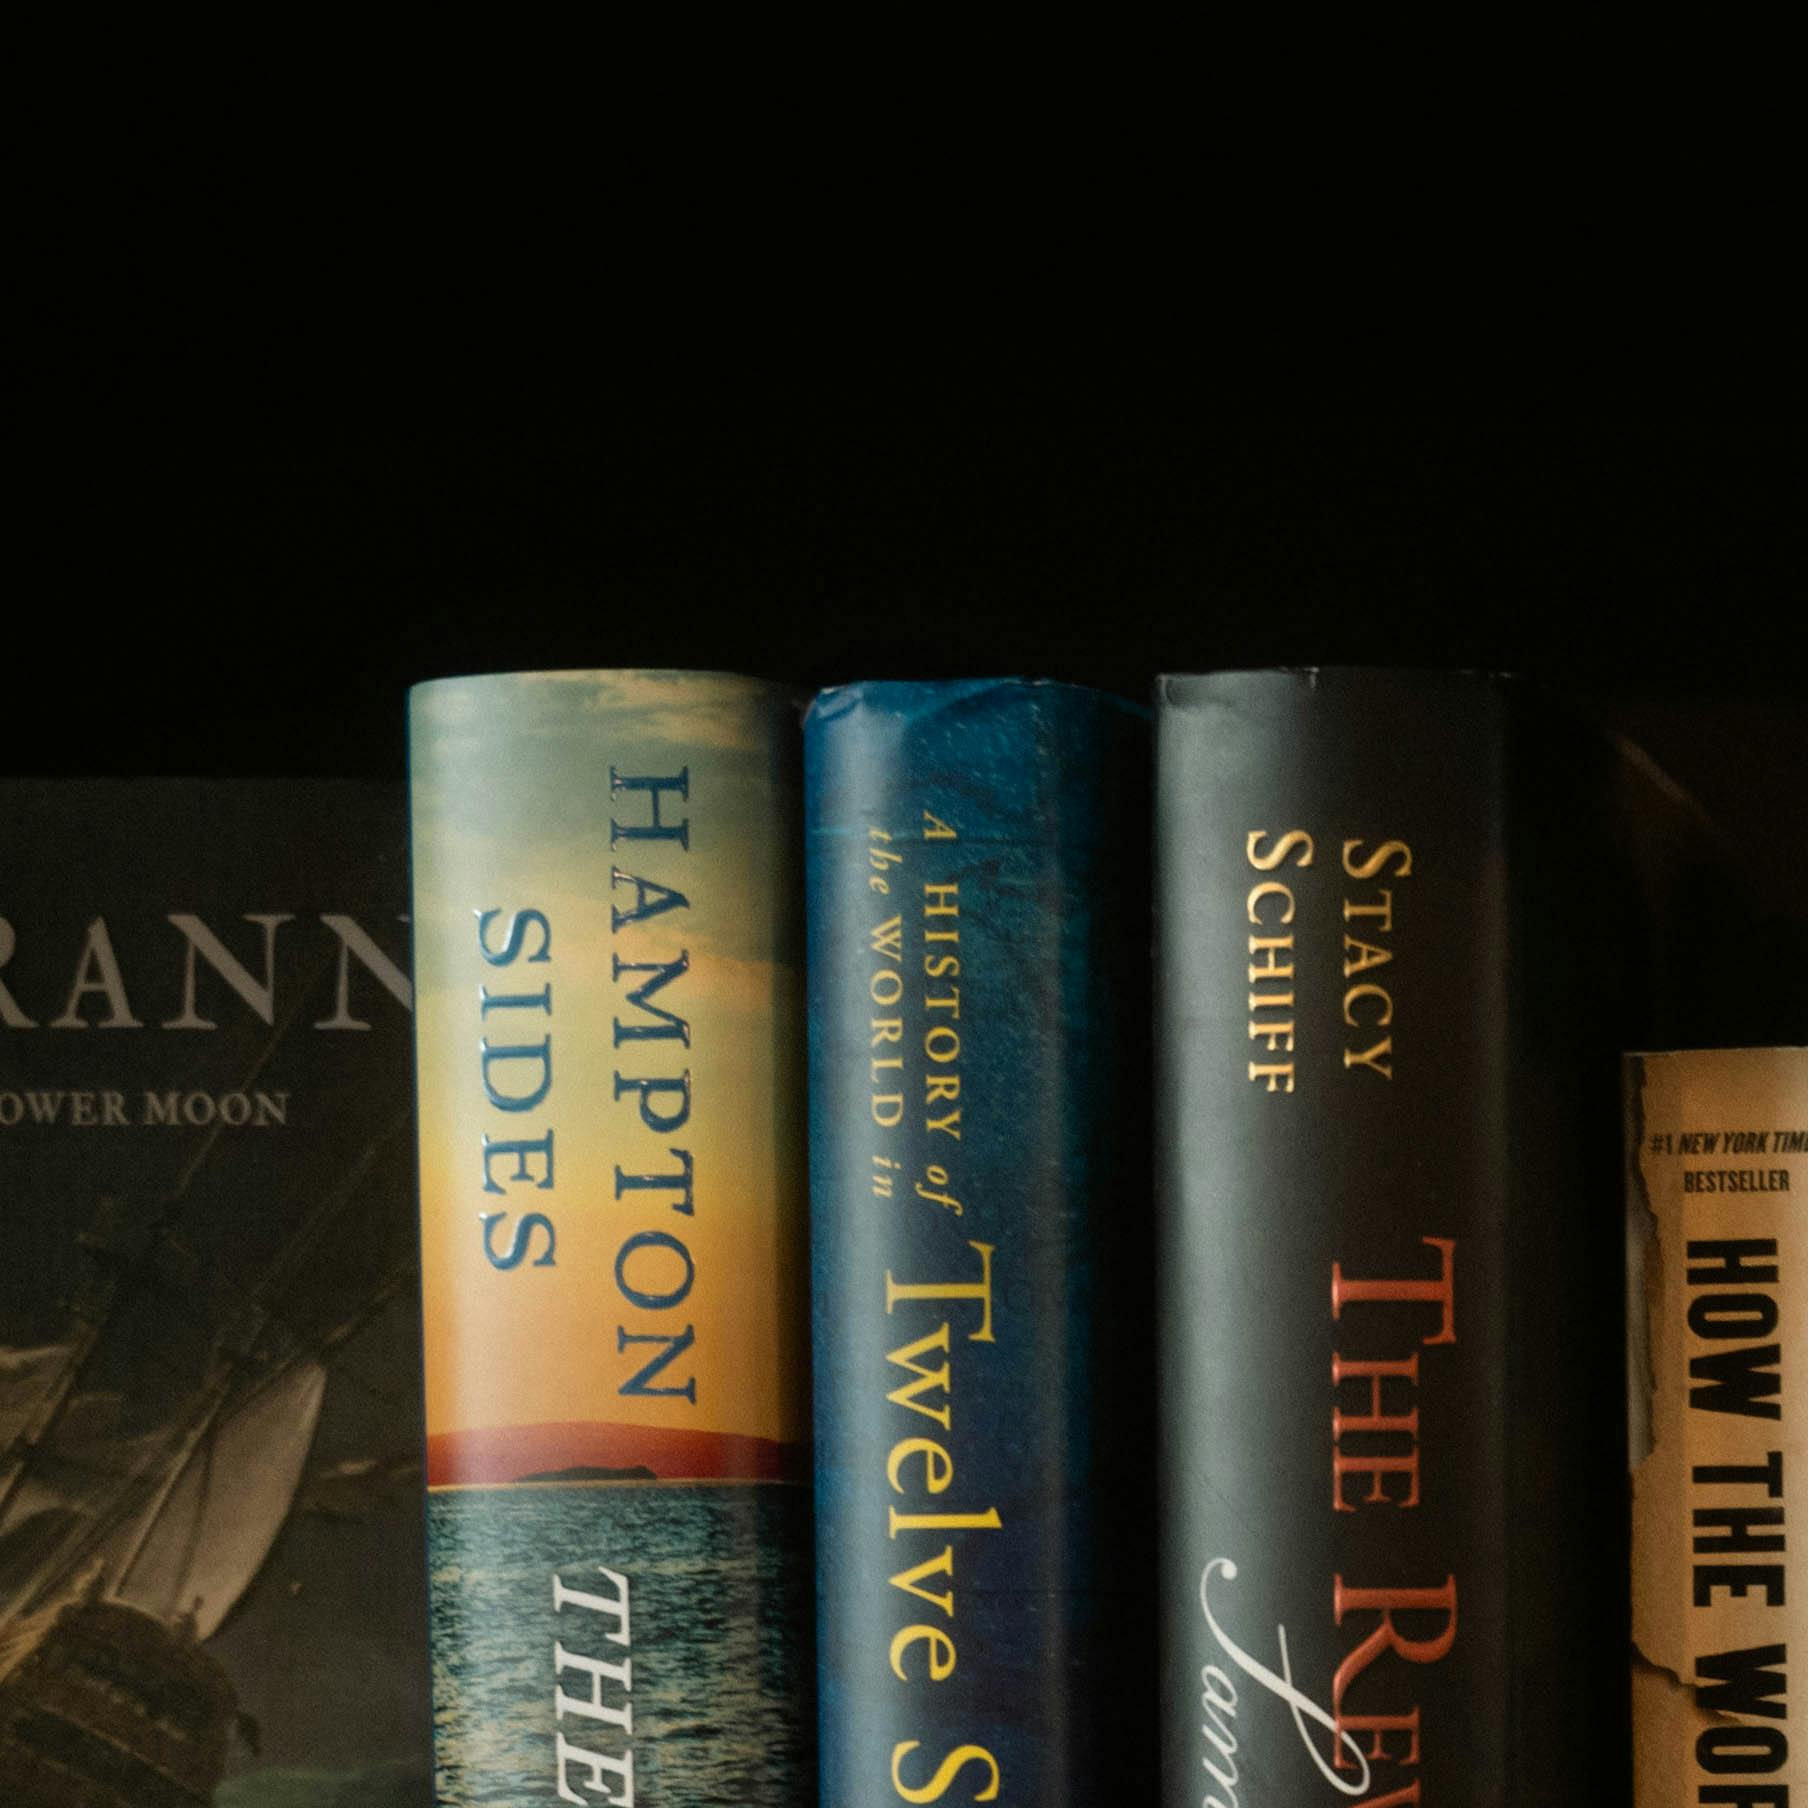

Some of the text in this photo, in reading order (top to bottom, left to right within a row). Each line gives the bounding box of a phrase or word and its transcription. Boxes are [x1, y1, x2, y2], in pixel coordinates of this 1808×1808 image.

[475, 908, 557, 1272] SIDES
[610, 766, 697, 1404] HAMPTON
[867, 826, 904, 1199] the WORLD in
[916, 810, 964, 1217] A HISTORY of
[1246, 828, 1315, 1094] SCHIFF
[1342, 838, 1413, 1081] STACY
[144, 1091, 288, 1128] MOON
[1649, 1134, 1674, 1156] #1
[1677, 1133, 1719, 1154] NEW
[1720, 1131, 1768, 1153] YORK
[1684, 1170, 1790, 1193] BESTSELLER
[885, 1239, 1005, 1684] Twelve
[1332, 1234, 1457, 1513] THE
[1685, 1238, 1783, 1421] HOW
[1691, 1450, 1786, 1608] THE
